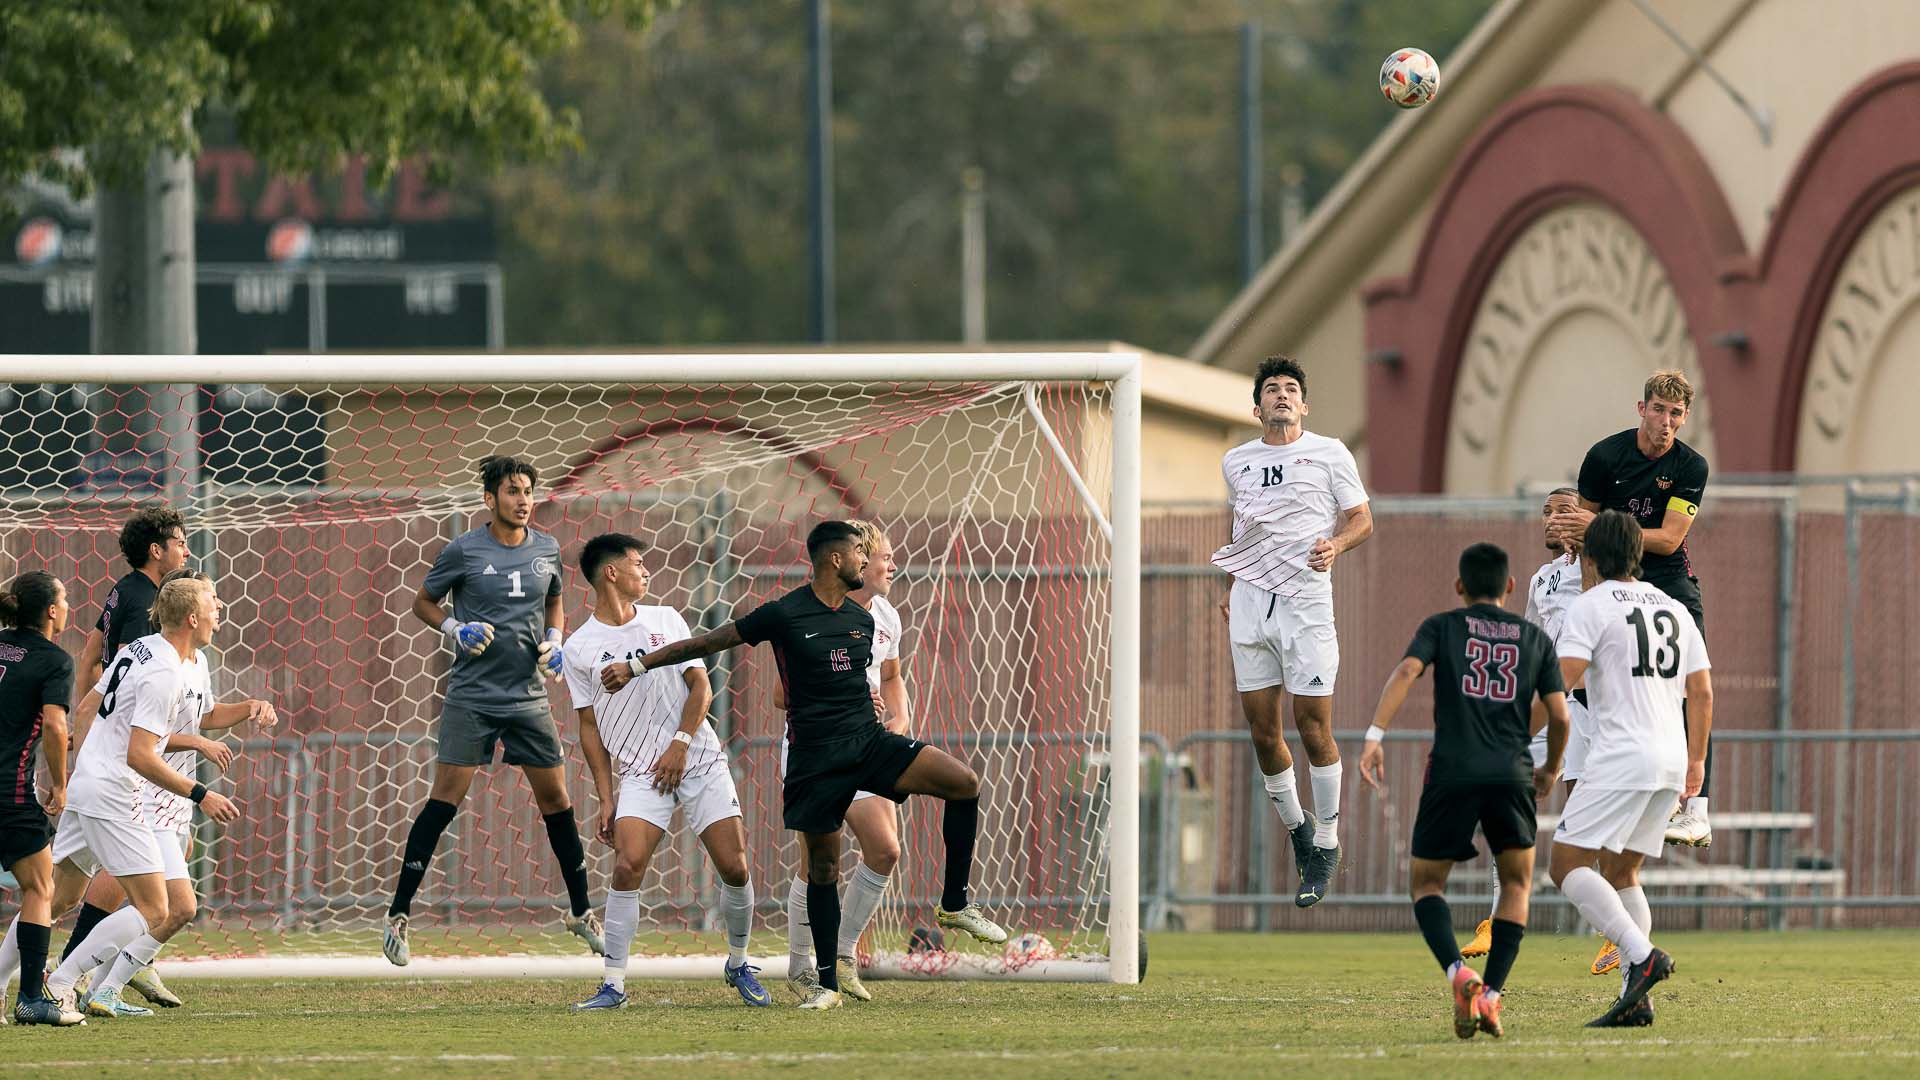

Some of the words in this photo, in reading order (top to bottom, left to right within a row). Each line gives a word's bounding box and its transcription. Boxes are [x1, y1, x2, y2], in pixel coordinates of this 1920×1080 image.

[1457, 213, 1706, 456] CONCESSION
[1261, 464, 1283, 487] 18
[1687, 505, 1696, 516] C
[507, 570, 526, 597] 1
[1465, 616, 1520, 639] TOROS
[1625, 607, 1680, 678] 13
[98, 657, 133, 719] 8
[1462, 637, 1519, 701] 33
